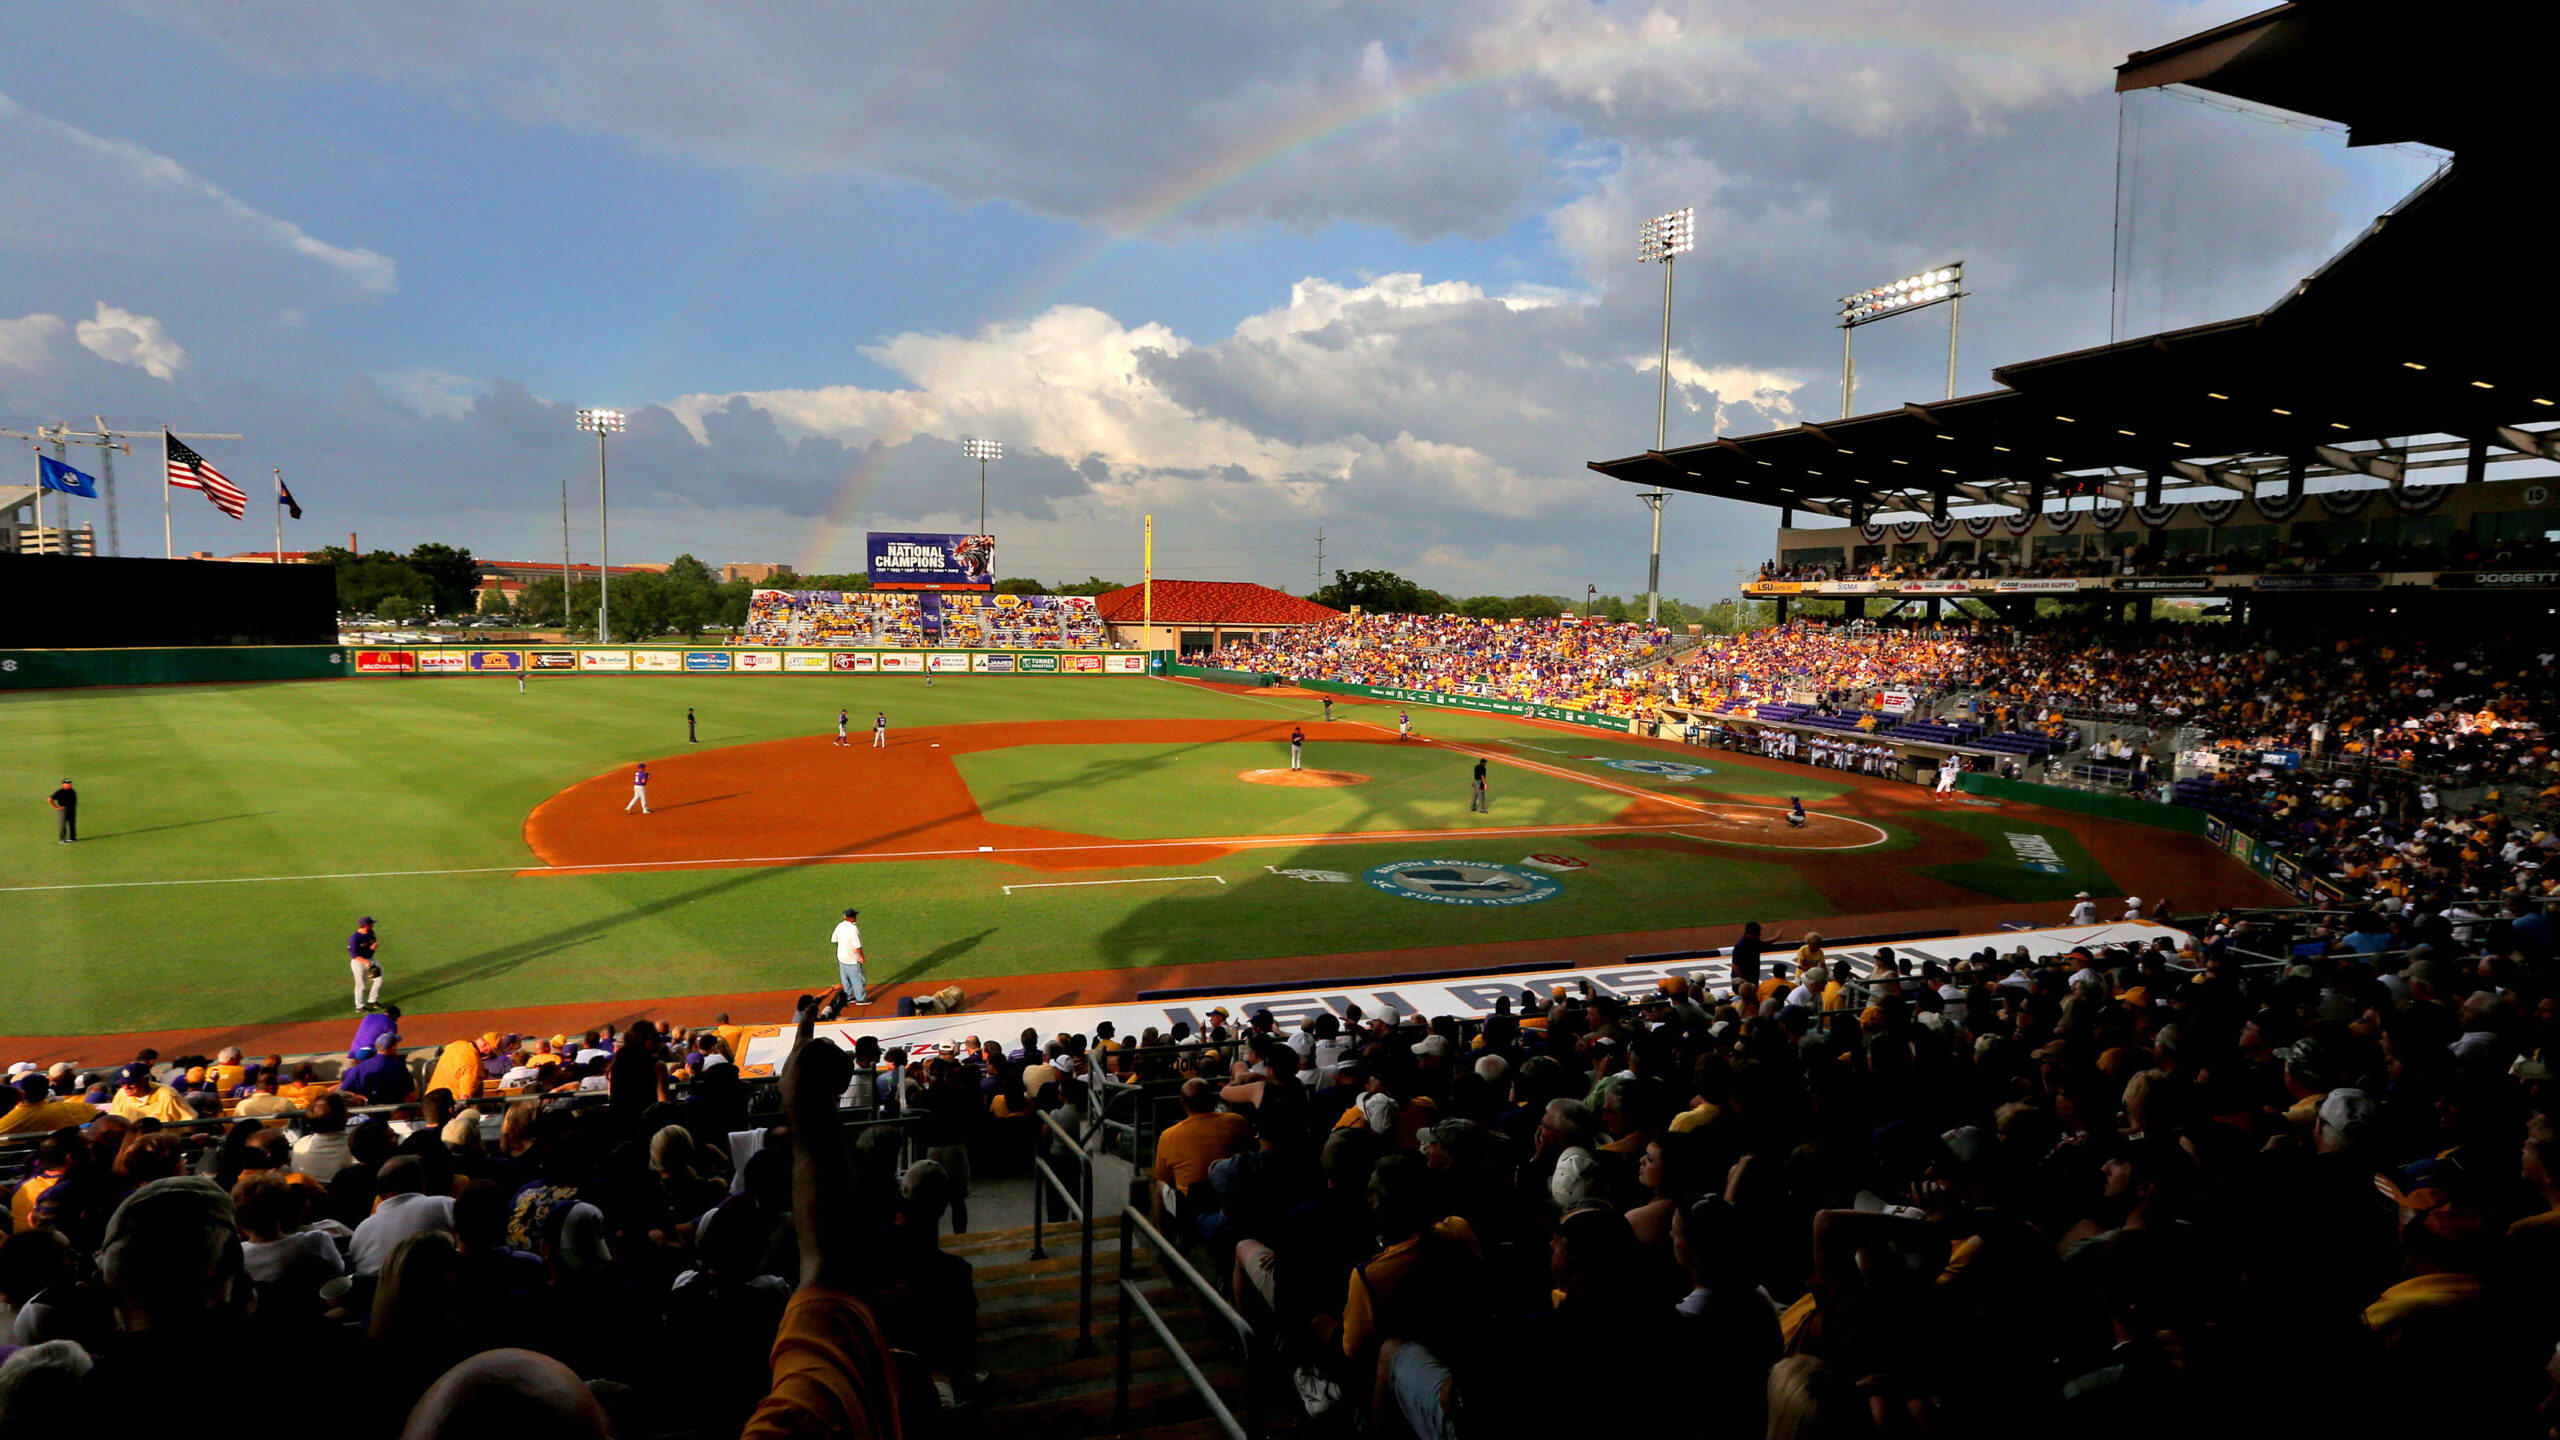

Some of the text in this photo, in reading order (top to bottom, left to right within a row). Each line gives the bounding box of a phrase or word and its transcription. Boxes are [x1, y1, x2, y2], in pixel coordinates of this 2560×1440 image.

[2077, 482, 2085, 492] 2
[2527, 488, 2545, 501] 15
[888, 545, 945, 558] NATIONAL
[875, 555, 946, 568] CHAMPIONS
[2475, 573, 2559, 583] DOGGETT
[941, 595, 983, 606] DECK
[788, 657, 827, 667] SUBWAY
[1432, 859, 1505, 869] ROUGE
[1401, 891, 1474, 905] SUPER
[744, 1065, 768, 1076] LSU
